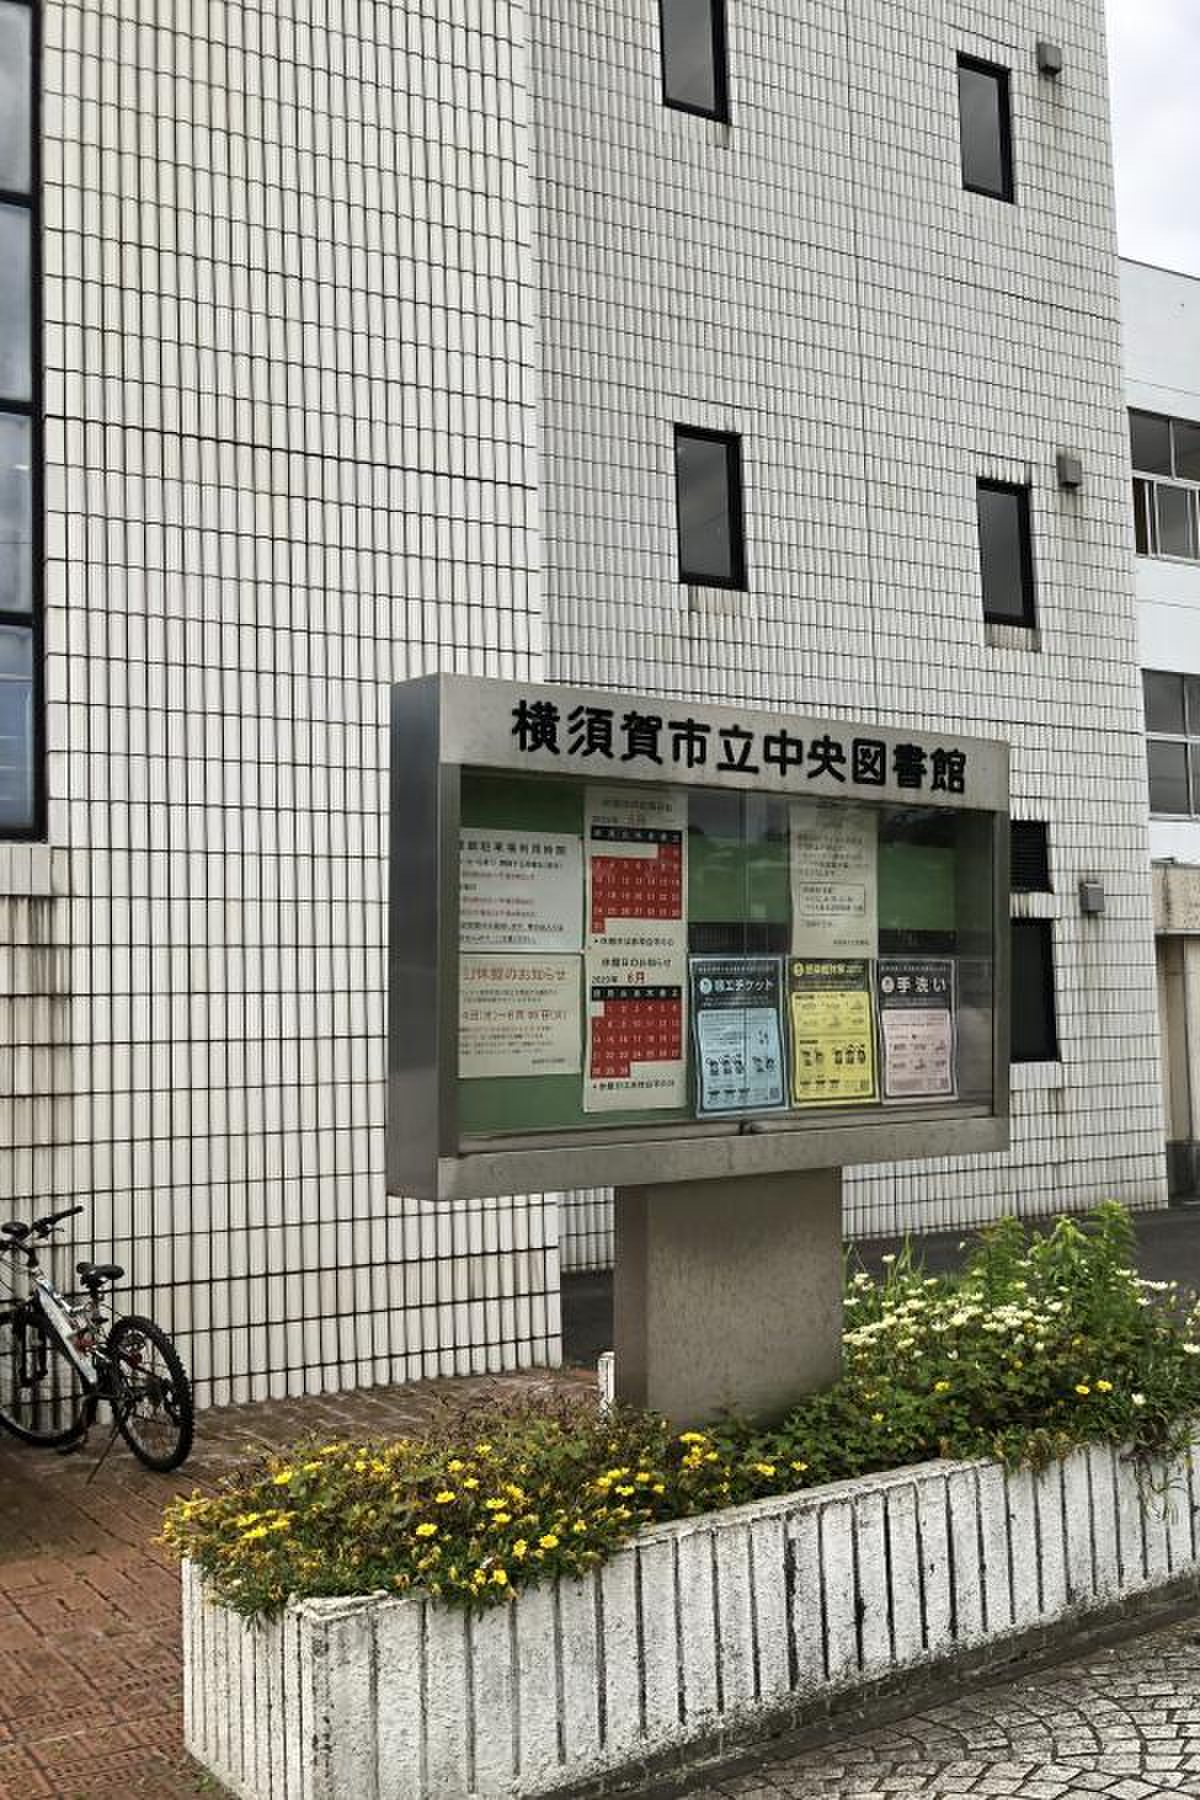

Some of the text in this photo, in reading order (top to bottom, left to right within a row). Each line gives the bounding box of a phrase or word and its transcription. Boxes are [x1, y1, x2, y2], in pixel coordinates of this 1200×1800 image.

[512, 699, 966, 794] 横須賀市立中央図書館
[627, 970, 645, 984] 6月
[897, 976, 946, 993] 手洗い
